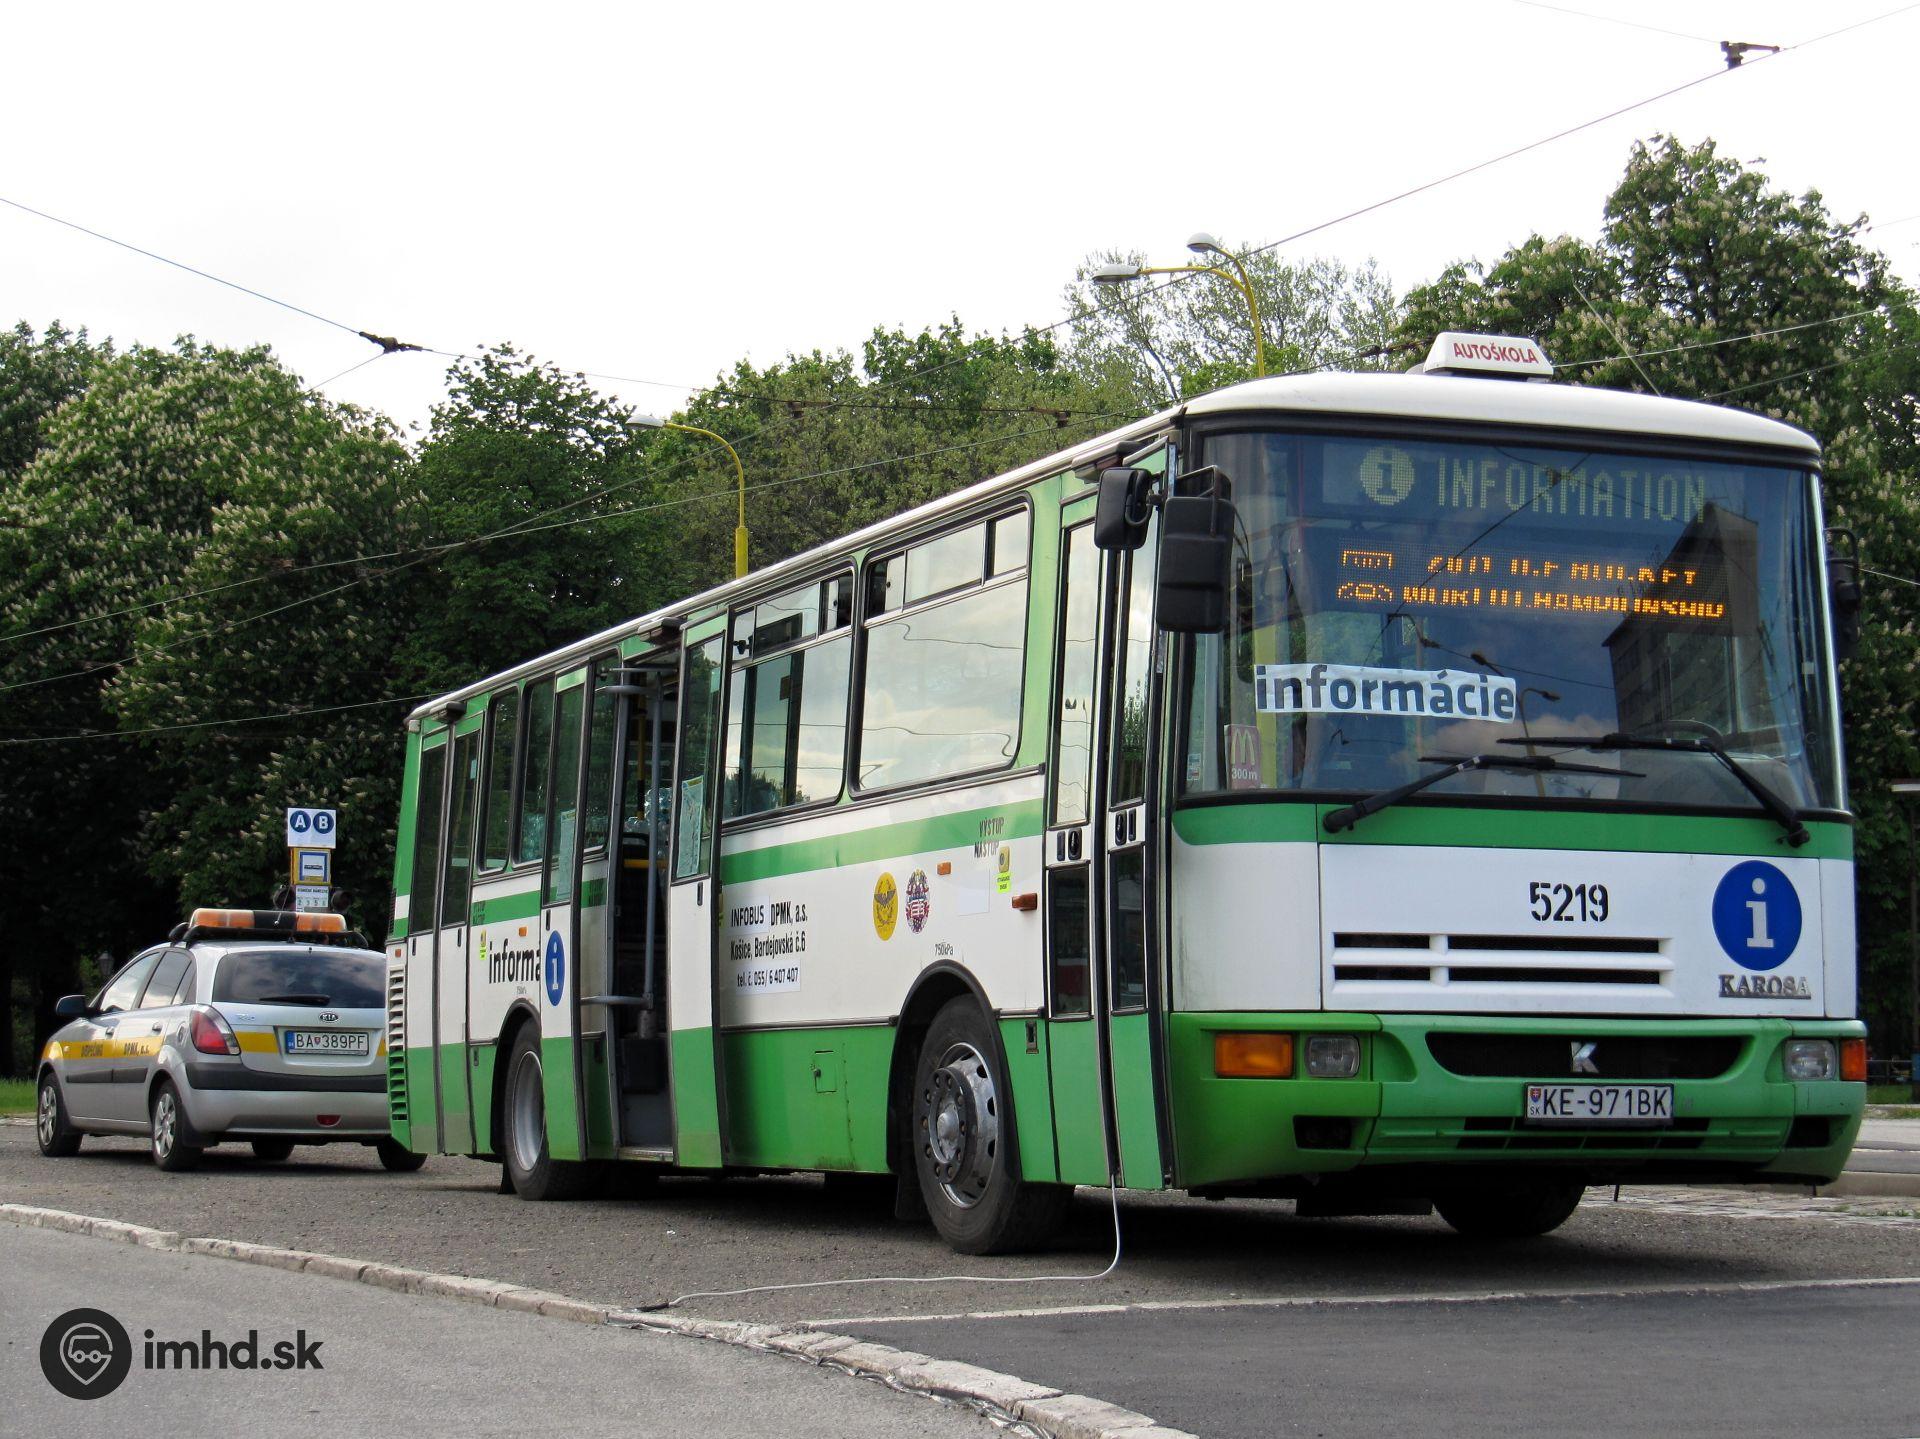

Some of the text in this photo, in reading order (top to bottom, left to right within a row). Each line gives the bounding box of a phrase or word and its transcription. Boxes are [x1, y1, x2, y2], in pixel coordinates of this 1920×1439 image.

[1453, 342, 1539, 364] AUTOŠKOLA
[1437, 456, 1705, 524] INFORMATION
[1256, 664, 1515, 720] informácie
[295, 815, 328, 829] A B
[731, 901, 808, 927] INFOBUS DPMK, a.s.
[1530, 881, 1608, 922] 5219
[731, 939, 752, 960] Košice,
[755, 932, 793, 958] Bardejovská
[1719, 974, 1811, 999] KAROSA
[321, 1013, 337, 1022] KIA
[297, 1034, 314, 1047] BA
[323, 1035, 365, 1049] 389PF
[1543, 1089, 1667, 1116] KE-971BK
